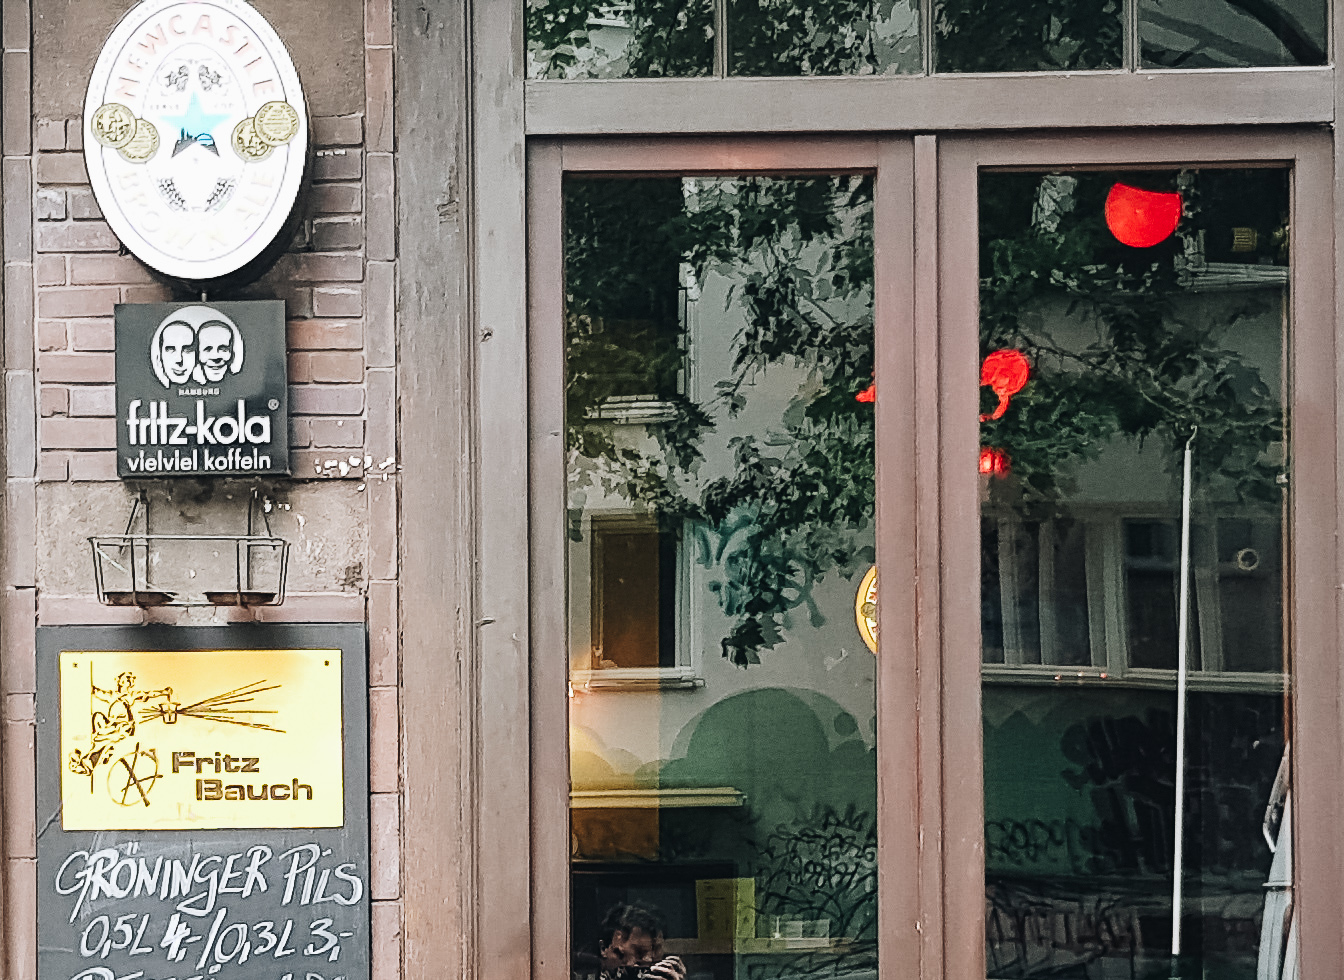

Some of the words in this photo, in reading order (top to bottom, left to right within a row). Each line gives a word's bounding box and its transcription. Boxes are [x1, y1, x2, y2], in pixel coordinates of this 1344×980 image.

[115, 14, 276, 100] NEWCASTLE
[127, 399, 272, 446] fritz-kola
[128, 449, 198, 472] vielviel
[204, 446, 271, 470] koffein
[172, 752, 260, 773] Fritz
[196, 778, 312, 800] Bauch
